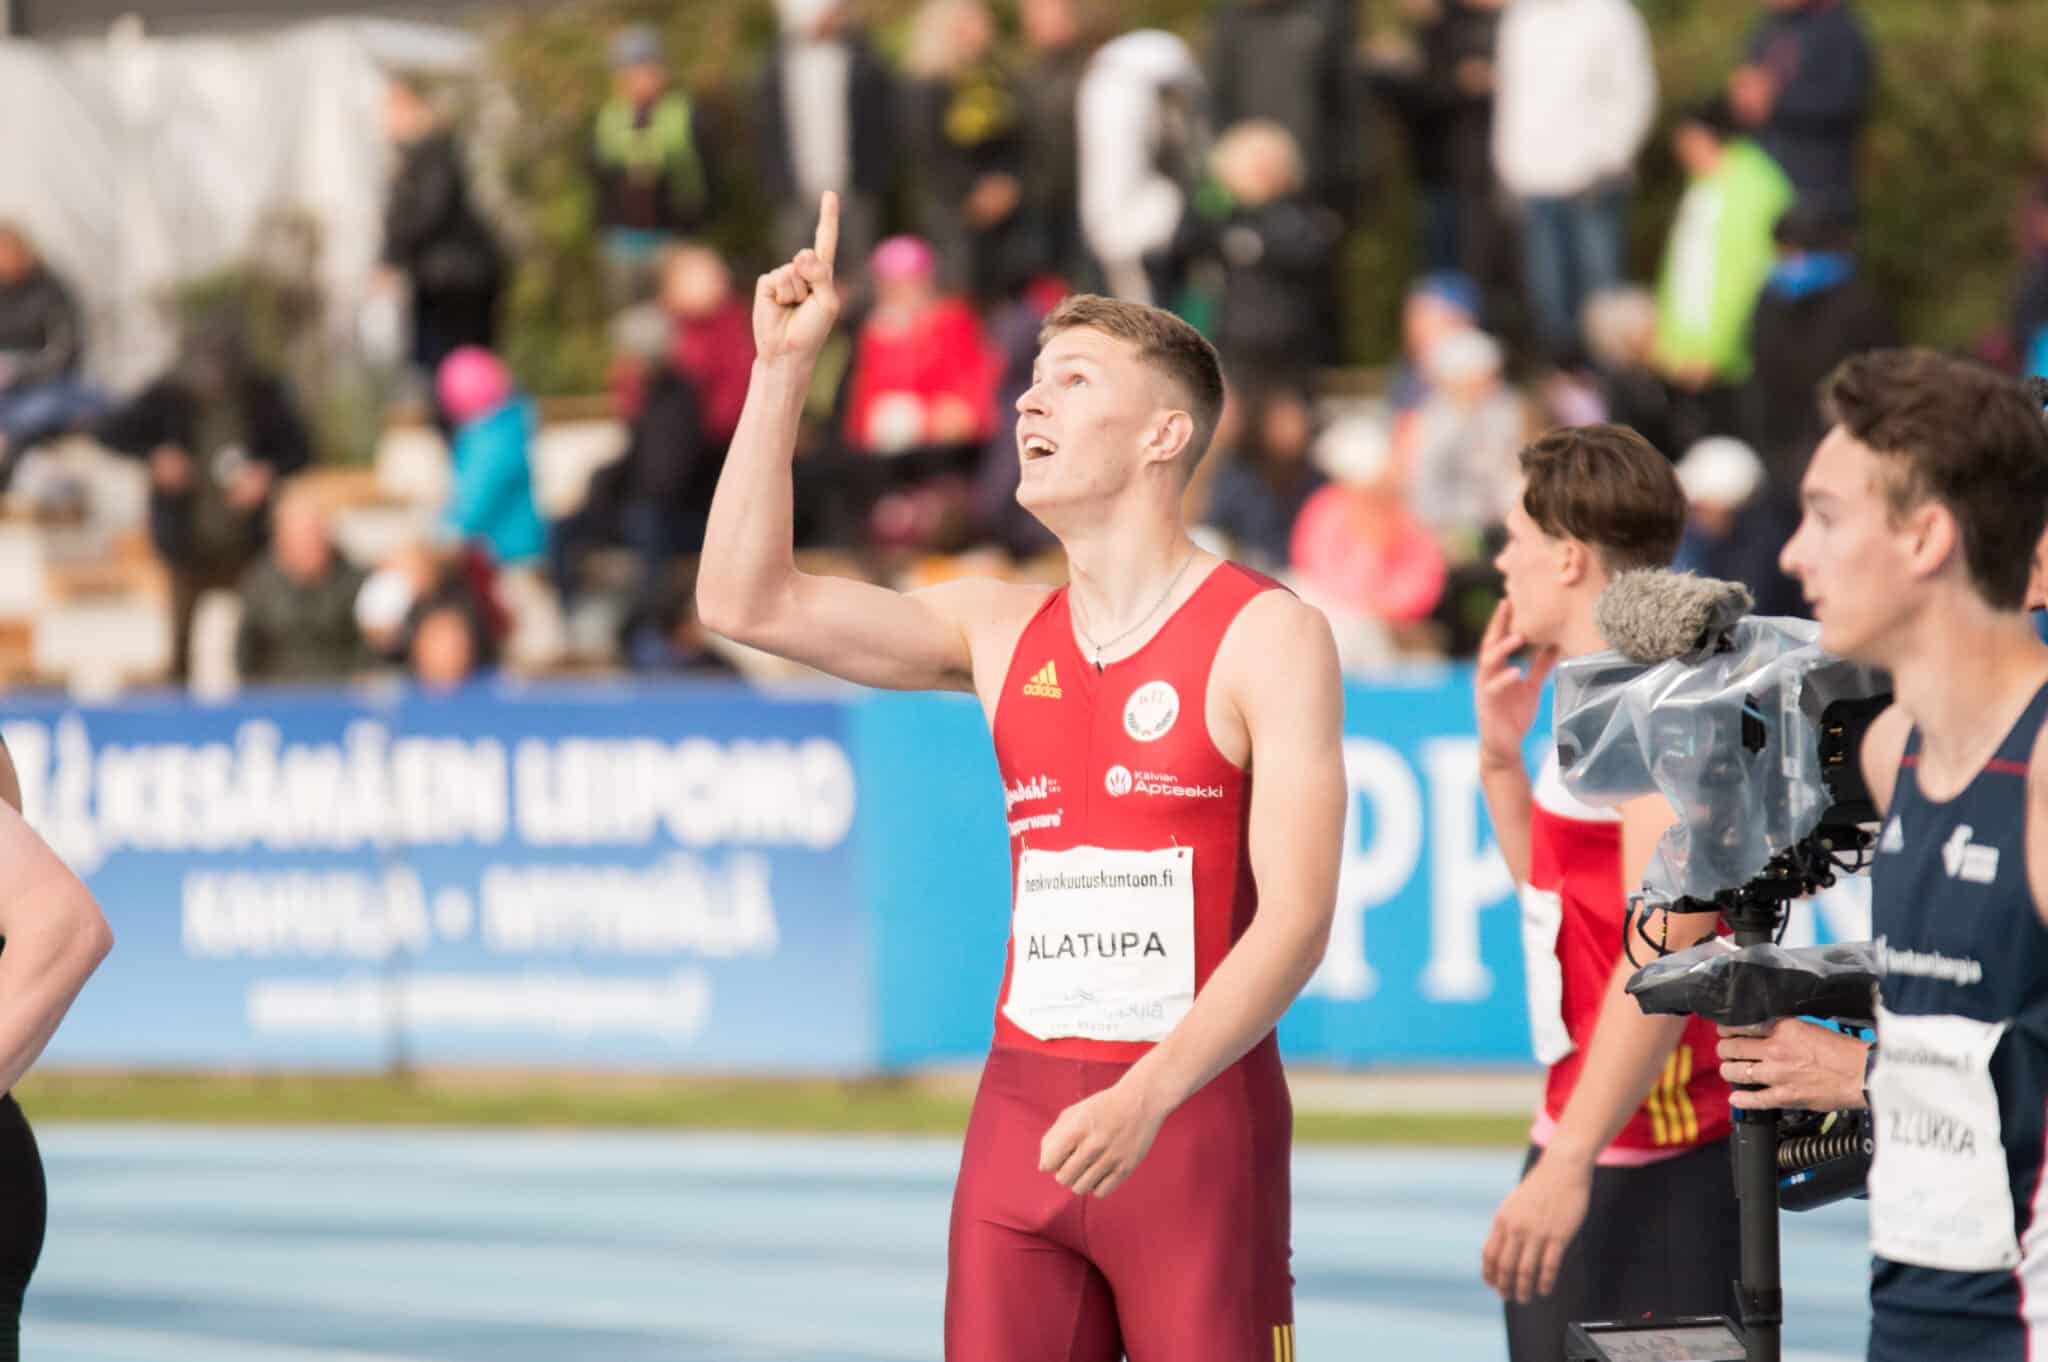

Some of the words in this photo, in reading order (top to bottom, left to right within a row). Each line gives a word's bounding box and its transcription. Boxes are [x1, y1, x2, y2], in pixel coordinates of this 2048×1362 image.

[1023, 684, 1063, 699] adidas
[1134, 780, 1225, 799] Apteekki
[1028, 931, 1168, 961] ALATUPA
